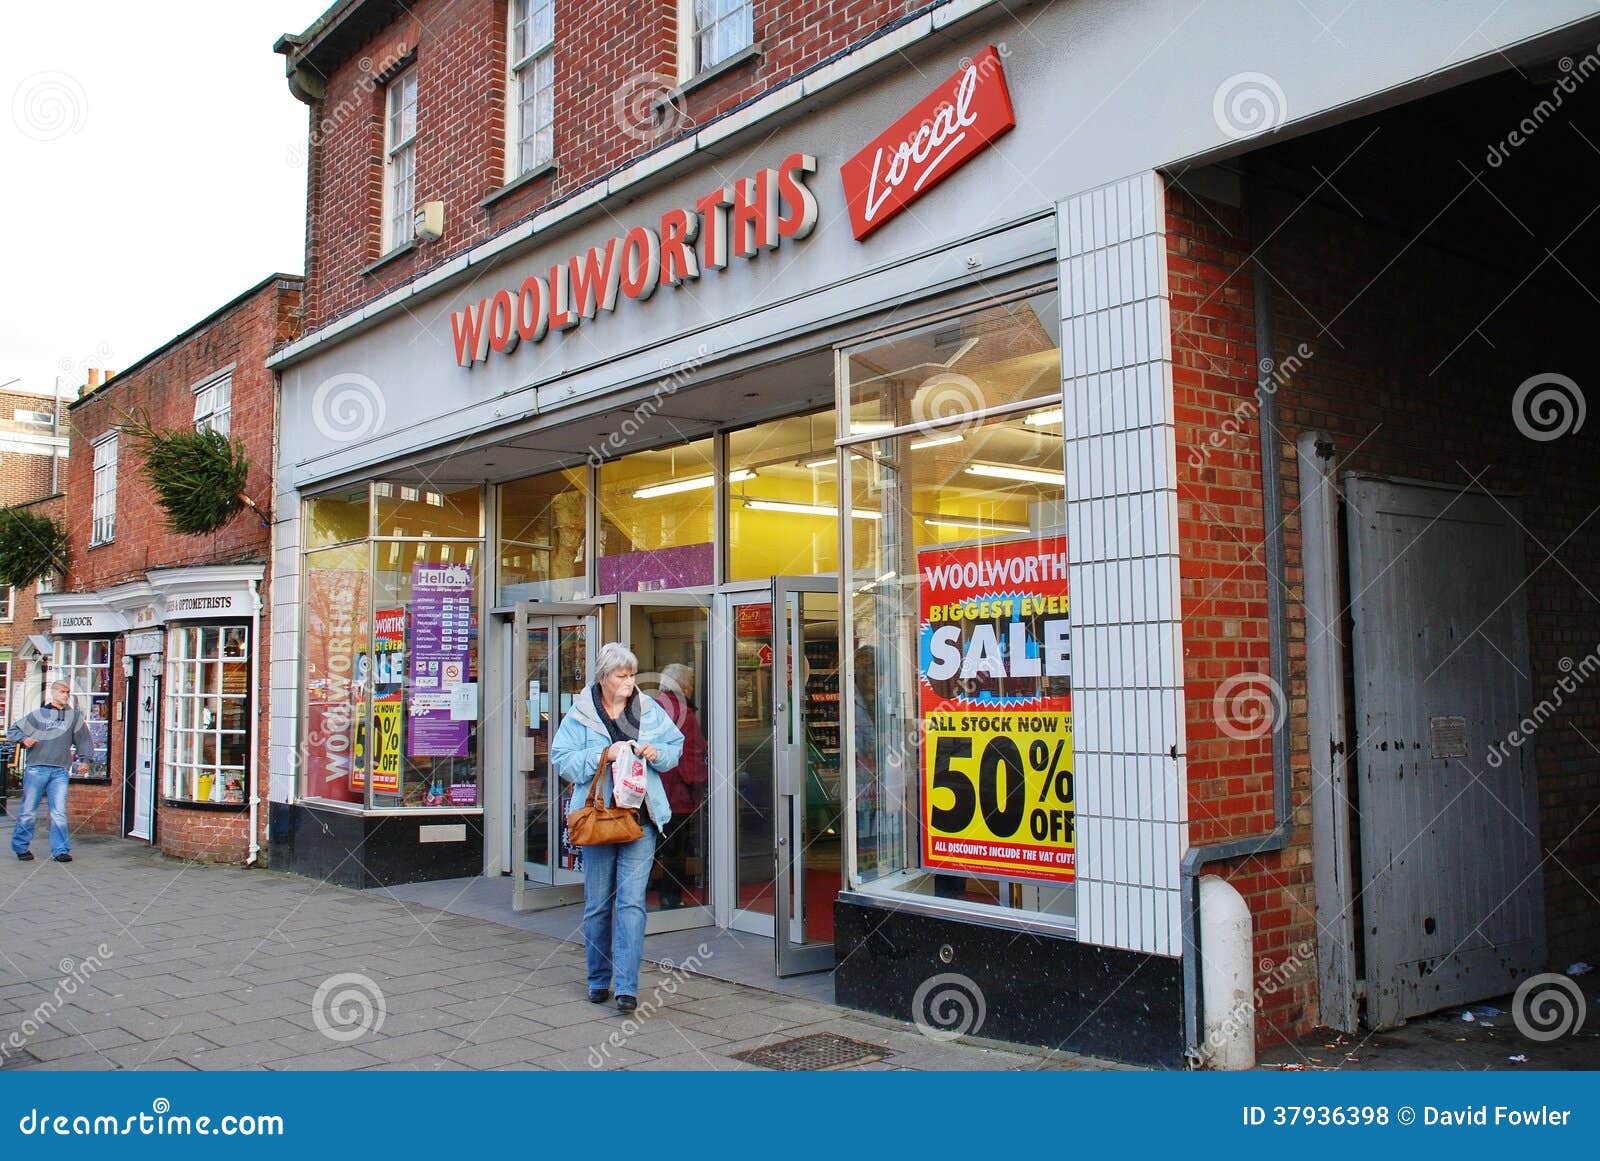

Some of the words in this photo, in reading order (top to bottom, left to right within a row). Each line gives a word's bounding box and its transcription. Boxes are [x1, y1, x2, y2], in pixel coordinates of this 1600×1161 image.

[865, 64, 977, 221] Local
[450, 153, 818, 368] WOOLWORTHS
[929, 599, 1013, 622] BIGGEST
[1021, 595, 1070, 617] EVER
[927, 619, 1071, 681] SALE
[929, 716, 956, 732] ALL
[960, 716, 1013, 732] STOCK
[1017, 716, 1059, 733] NOW
[382, 753, 398, 771] OFF
[1030, 808, 1074, 843] OFF
[934, 840, 947, 852] ALL
[948, 842, 988, 856] DISCOUNTS
[989, 846, 1021, 859] INCLUDE
[1022, 849, 1037, 861] THE
[1038, 851, 1054, 863] VAT
[1056, 852, 1074, 865] CUT!
